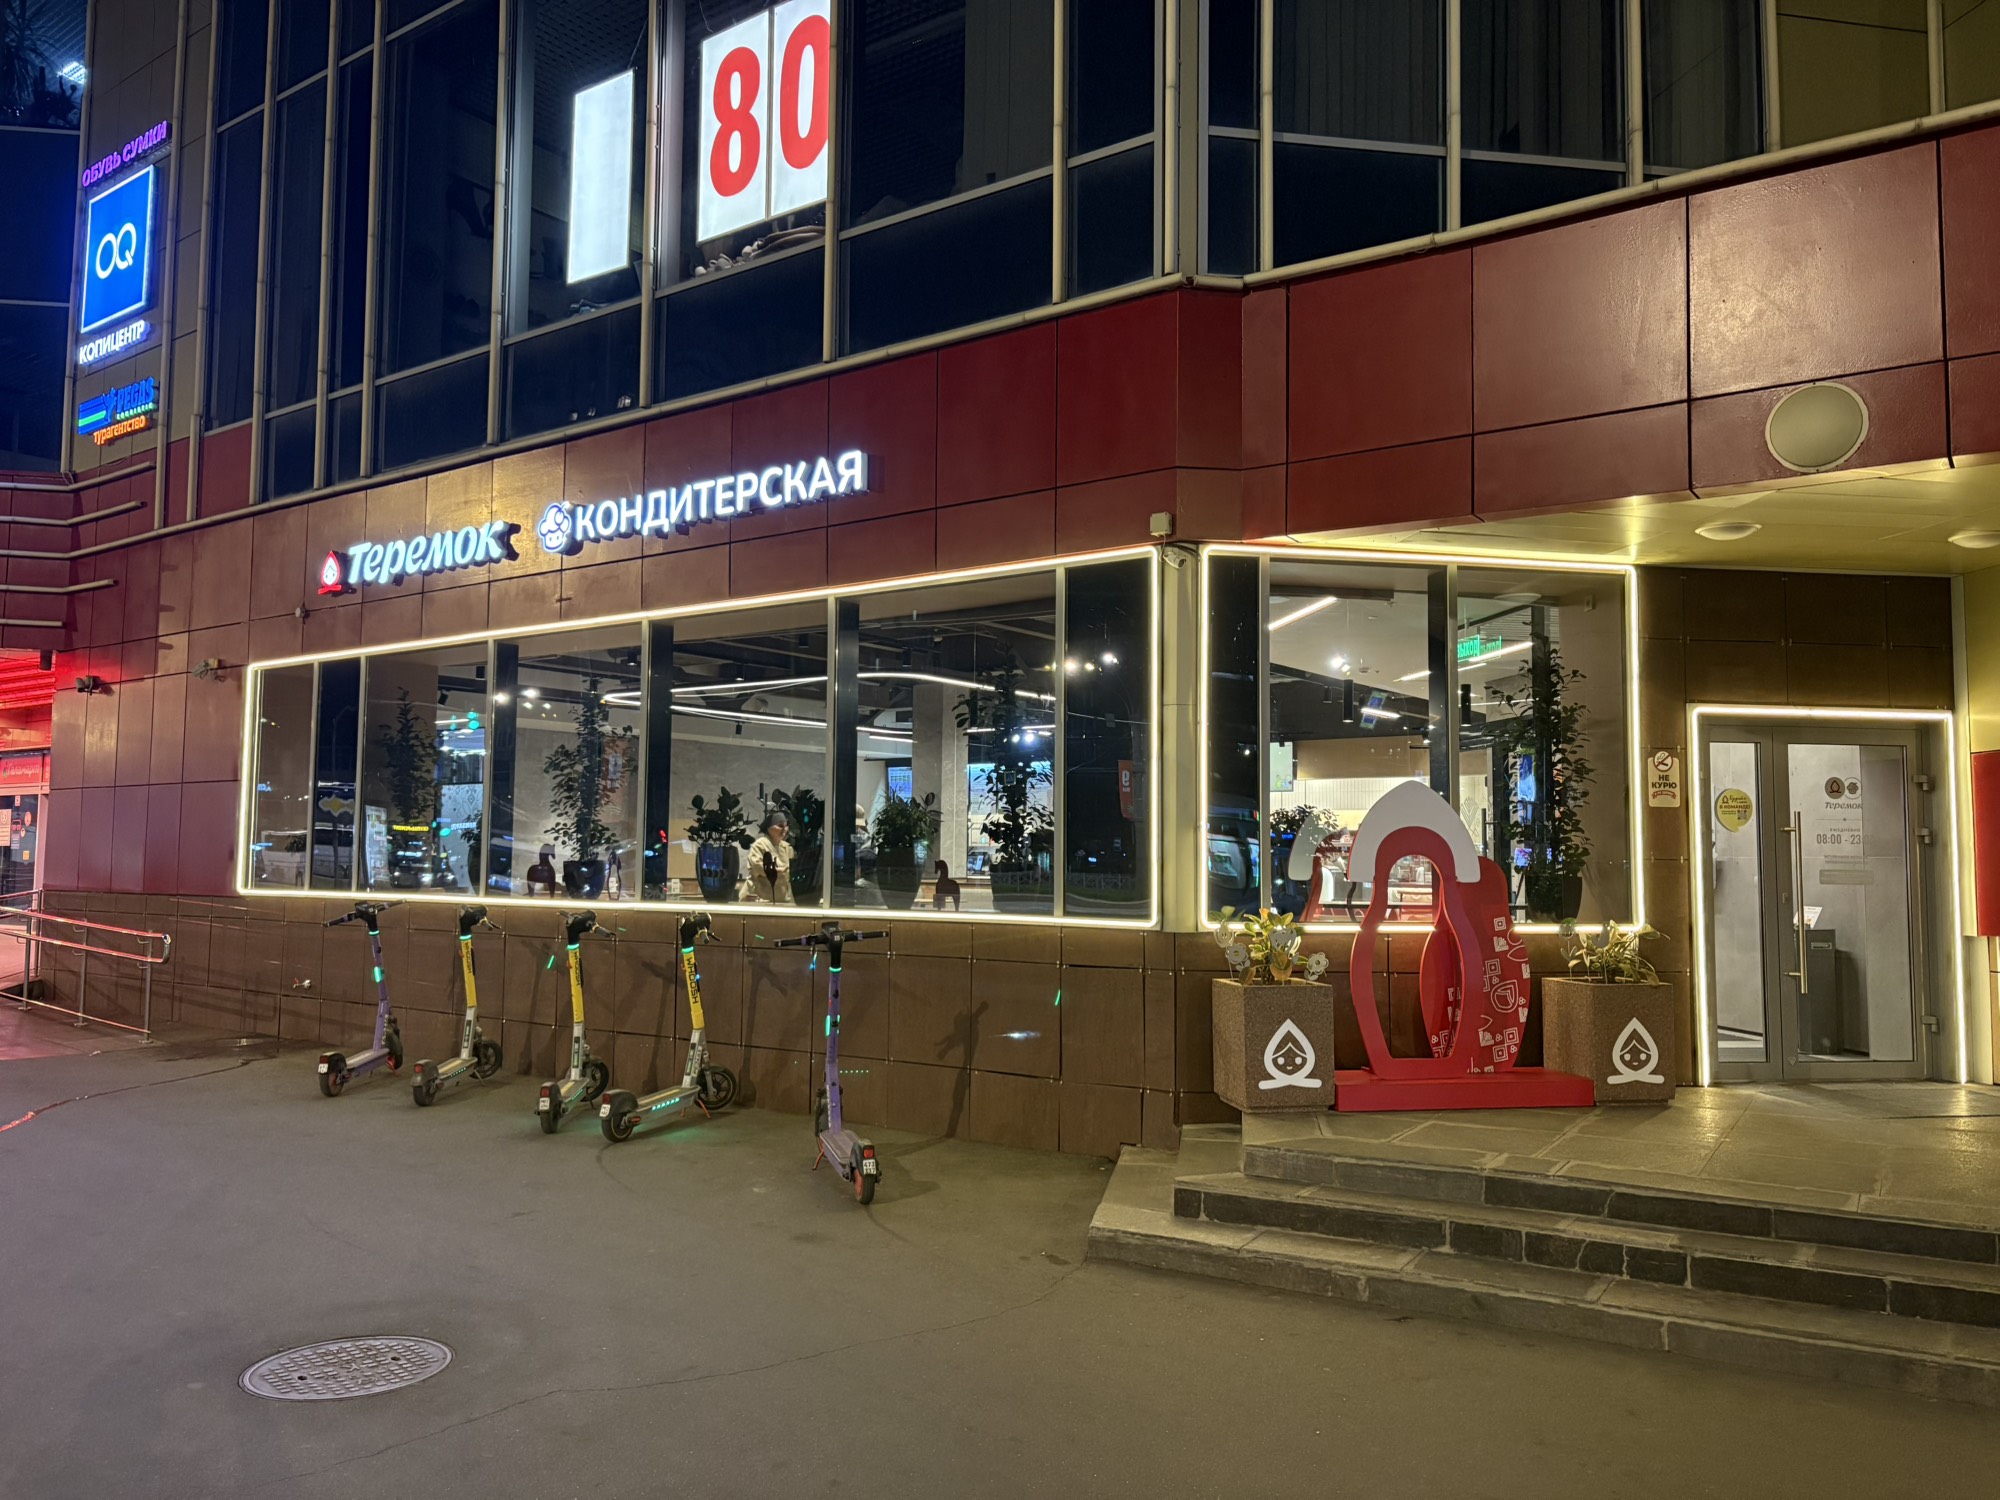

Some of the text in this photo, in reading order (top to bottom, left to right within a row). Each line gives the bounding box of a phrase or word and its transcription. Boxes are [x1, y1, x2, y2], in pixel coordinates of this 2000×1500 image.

[709, 14, 831, 197] 80
[82, 120, 167, 187] ОБУВЬ СУМКИ
[79, 319, 146, 365] КОПИЦЕНТР
[116, 376, 155, 413] PEGAS
[348, 450, 865, 584] Теремок КОНДИТЕРСКАЯ
[1658, 774, 1670, 782] НЕ
[1816, 833, 1842, 845] 08:00
[686, 956, 700, 1005] WHOOSH
